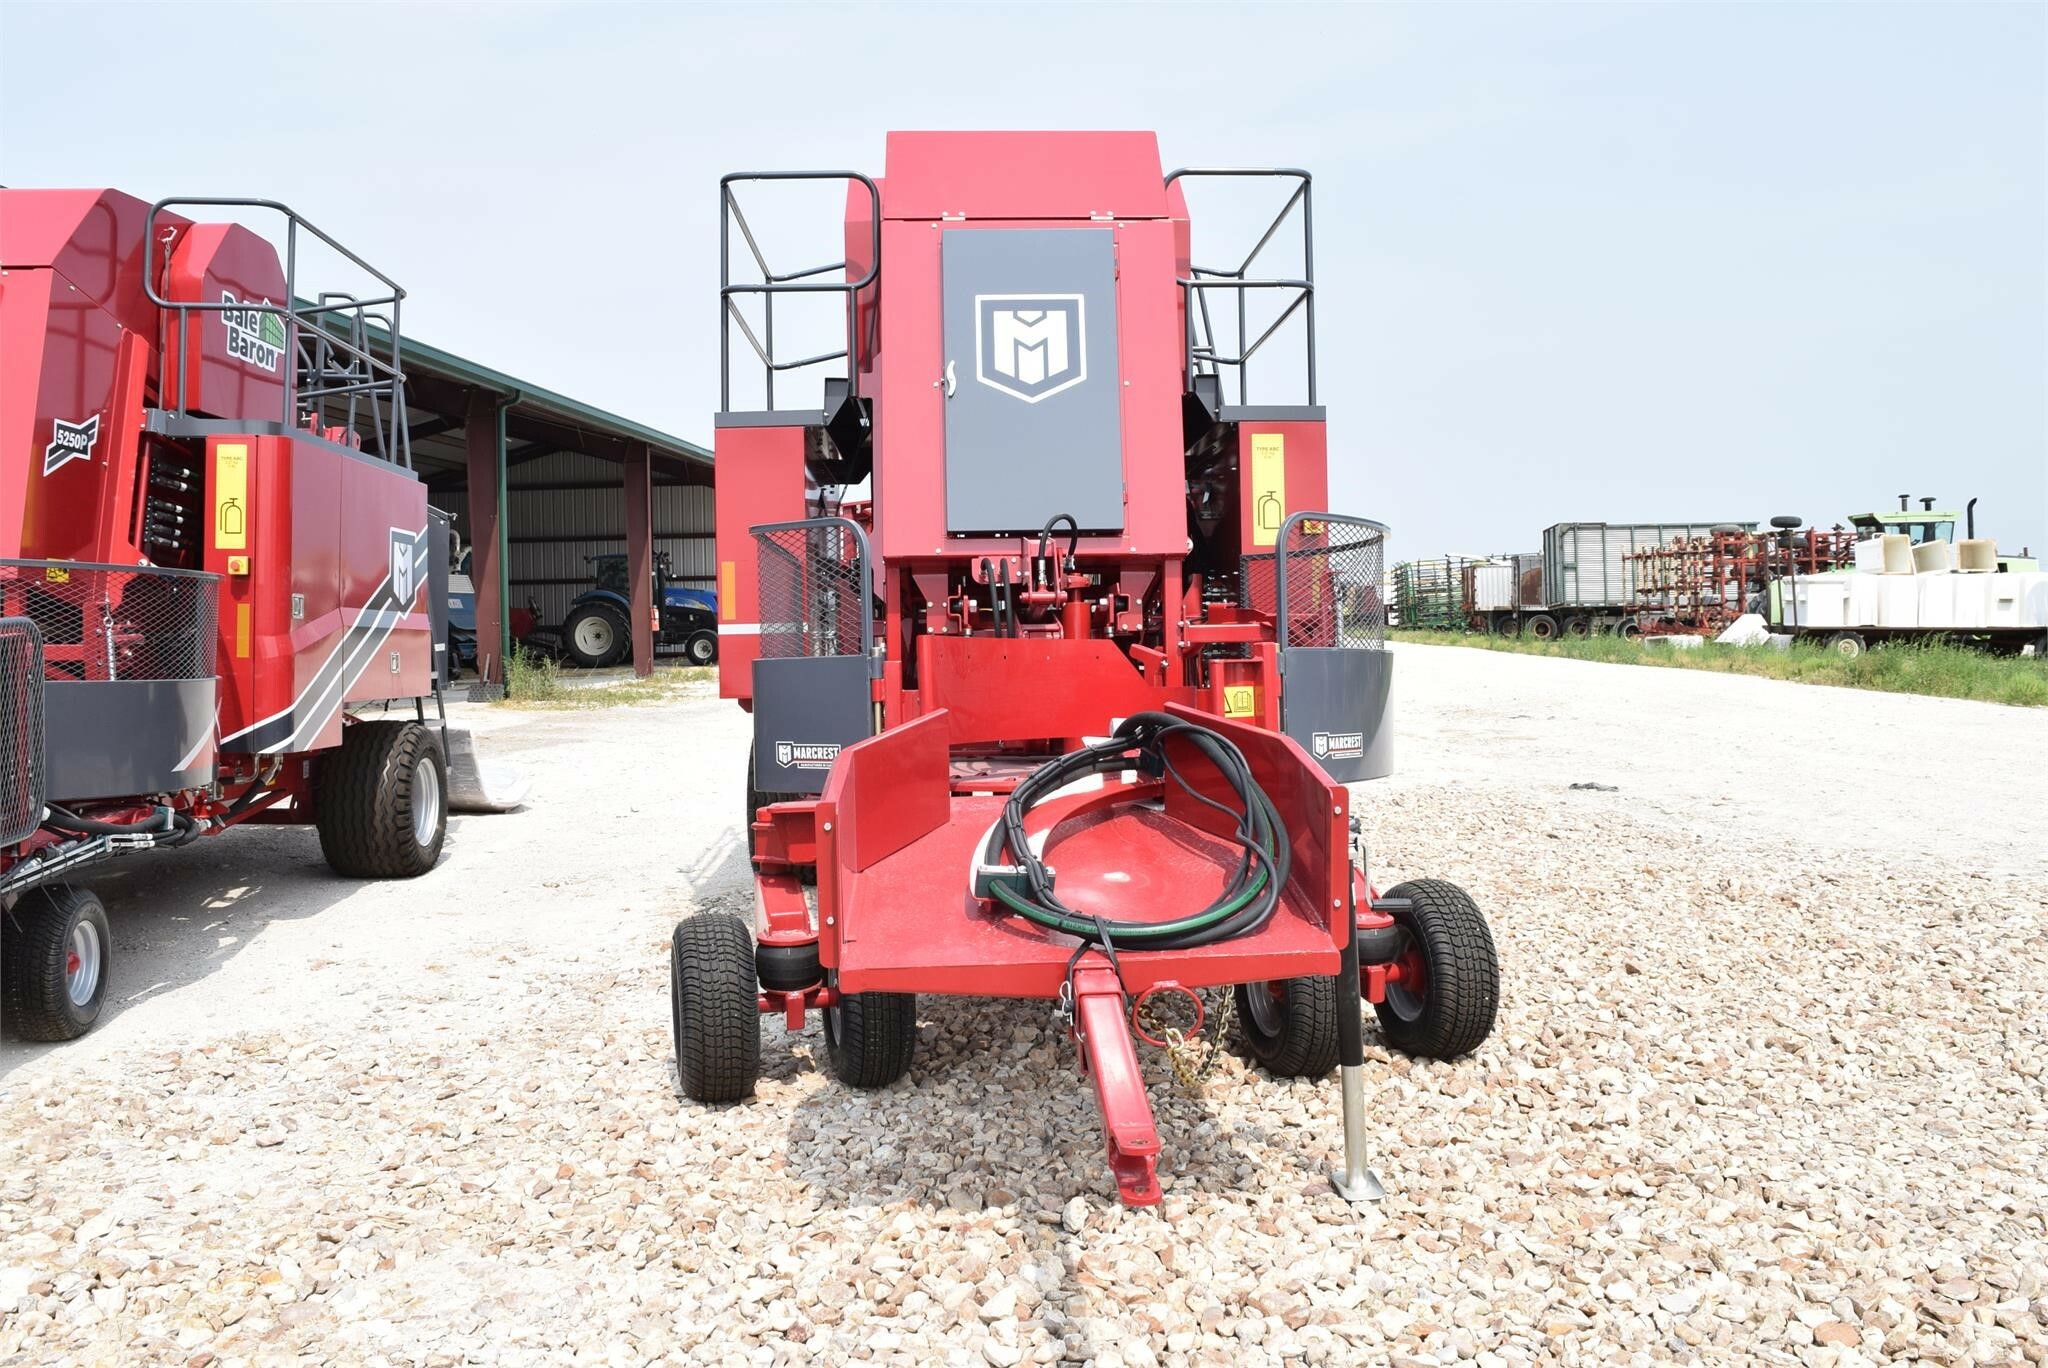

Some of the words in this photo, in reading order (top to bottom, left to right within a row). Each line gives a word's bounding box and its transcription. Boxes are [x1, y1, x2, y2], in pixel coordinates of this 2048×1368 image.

[223, 293, 258, 335] Bale
[228, 325, 275, 369] Baron
[57, 429, 88, 450] 5250P
[793, 747, 839, 760] MARCREST
[1329, 736, 1361, 750] MARCREST
